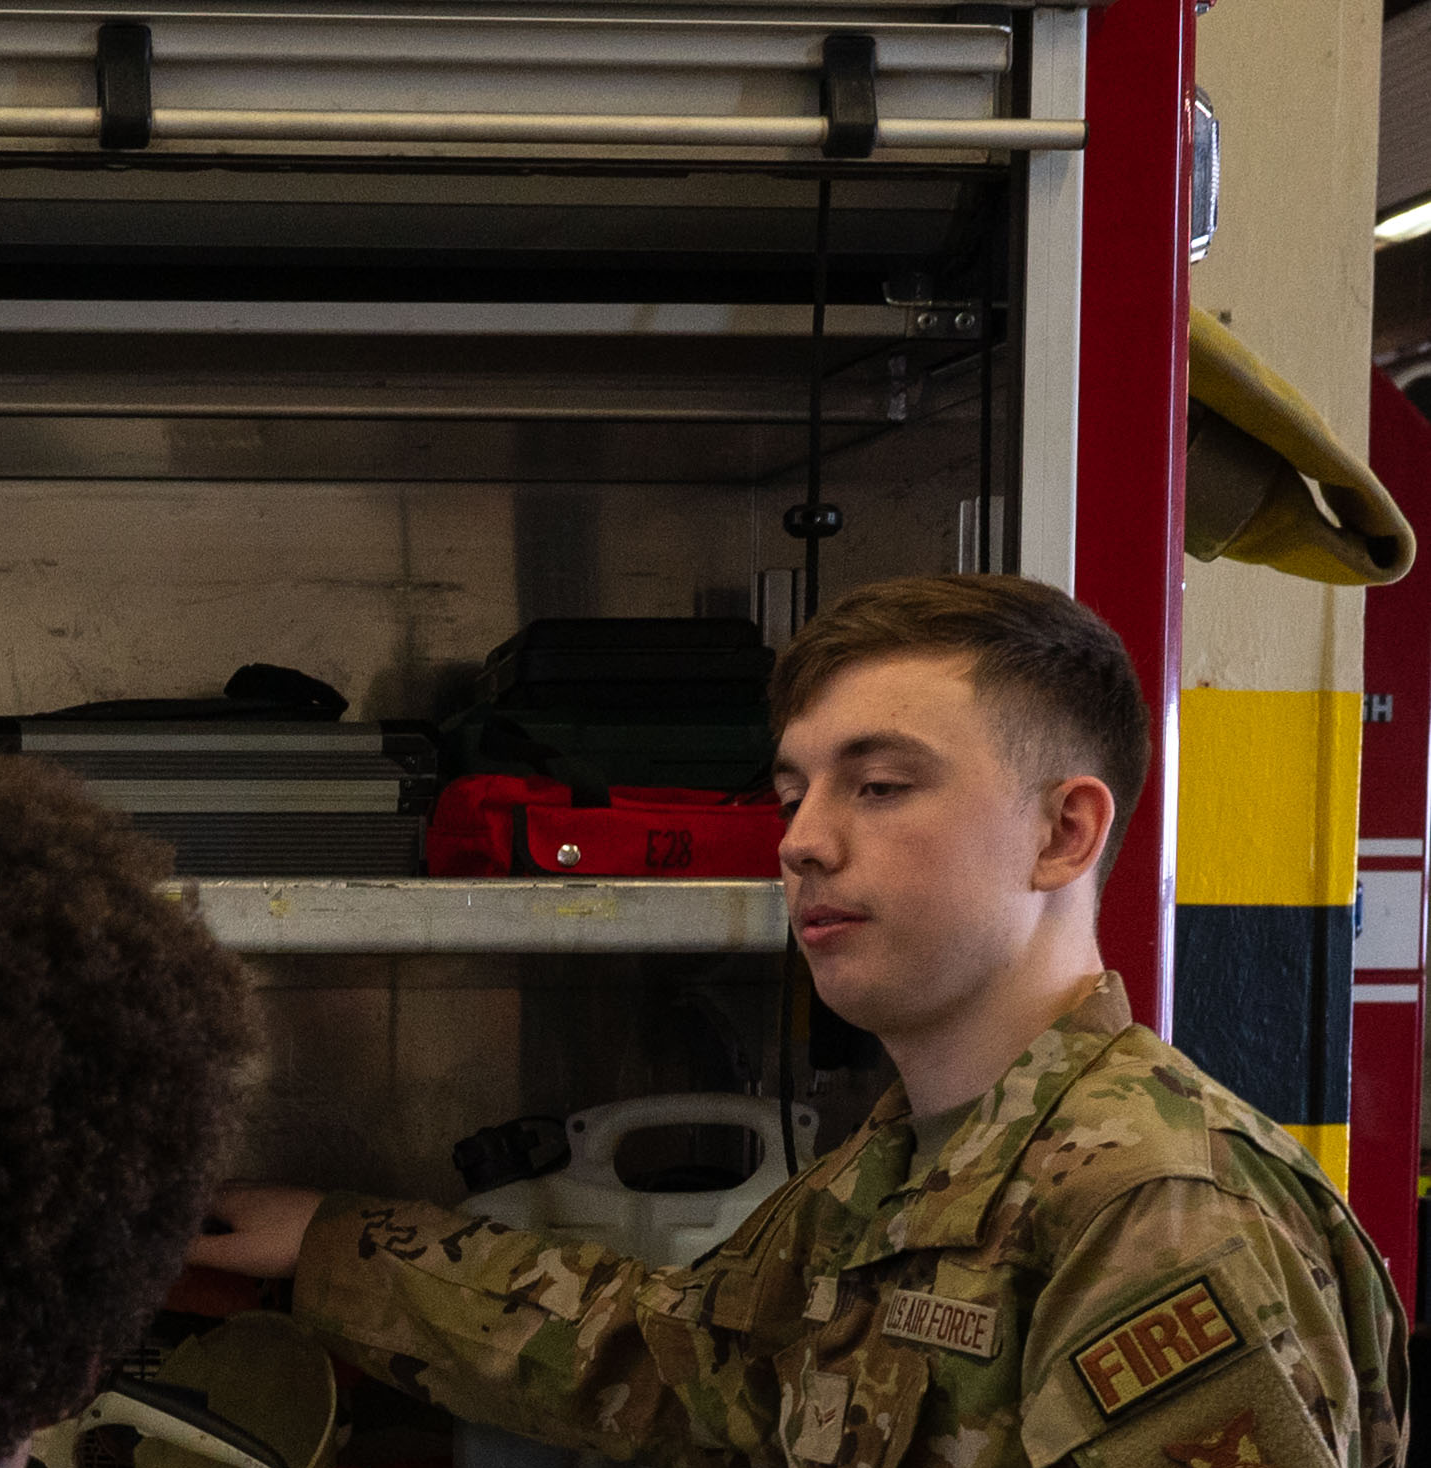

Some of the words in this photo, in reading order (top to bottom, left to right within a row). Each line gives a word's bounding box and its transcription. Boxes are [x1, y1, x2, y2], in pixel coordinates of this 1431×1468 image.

[902, 1298, 930, 1335] AIR
[924, 1303, 988, 1349] FORCE
[1081, 1289, 1232, 1408] FIRE
